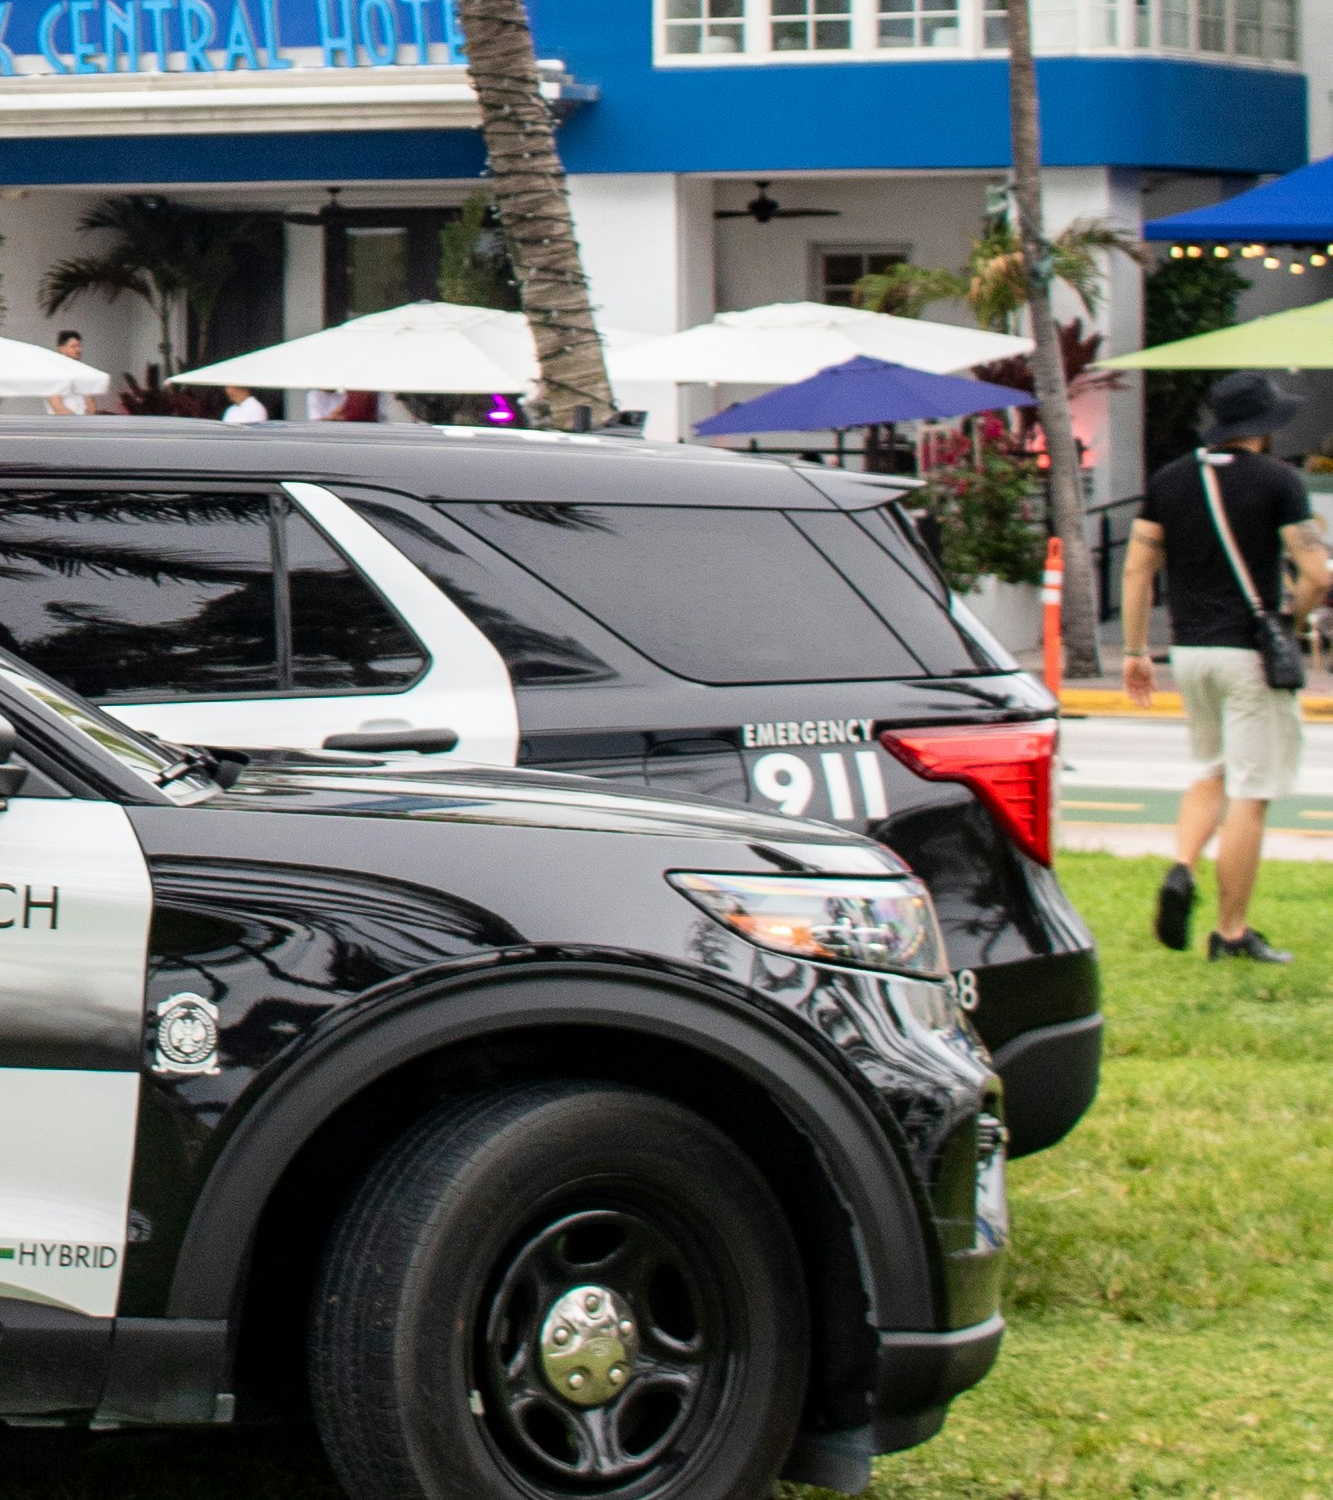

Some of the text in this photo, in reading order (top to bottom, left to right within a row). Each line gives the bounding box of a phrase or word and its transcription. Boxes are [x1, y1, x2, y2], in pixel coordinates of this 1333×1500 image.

[743, 719, 875, 748] EMERGENCY
[753, 750, 889, 821] 911
[18, 1242, 118, 1269] HYBRID
